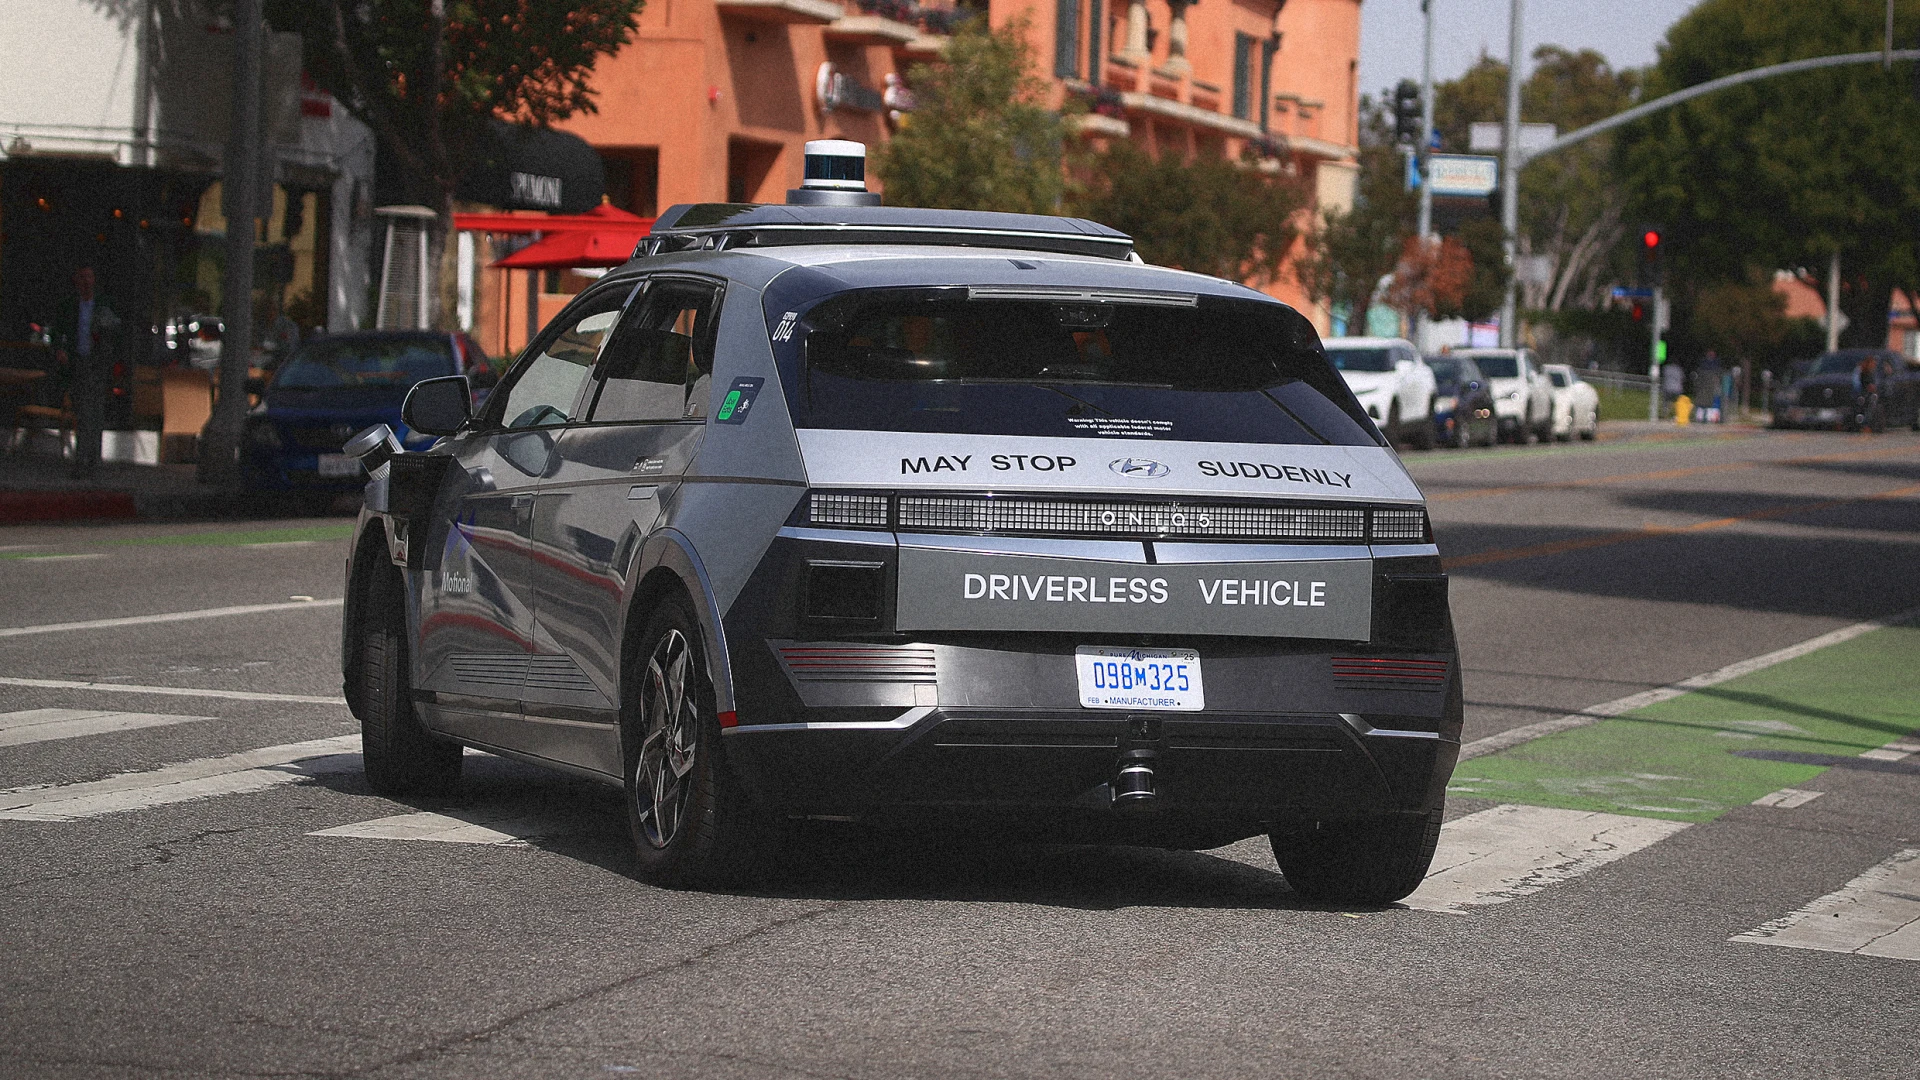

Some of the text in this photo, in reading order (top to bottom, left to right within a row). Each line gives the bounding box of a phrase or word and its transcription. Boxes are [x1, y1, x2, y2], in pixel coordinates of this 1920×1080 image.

[772, 320, 796, 342] 014
[901, 454, 1352, 489] MAY STOP SUDDENLY
[1084, 511, 1210, 528] IONIQ 5
[442, 571, 472, 593] Motional
[964, 573, 1326, 607] DRIVERLESS VEHICLE
[1093, 662, 1189, 691] 098M325
[1109, 697, 1175, 706] MANUFACTURER
